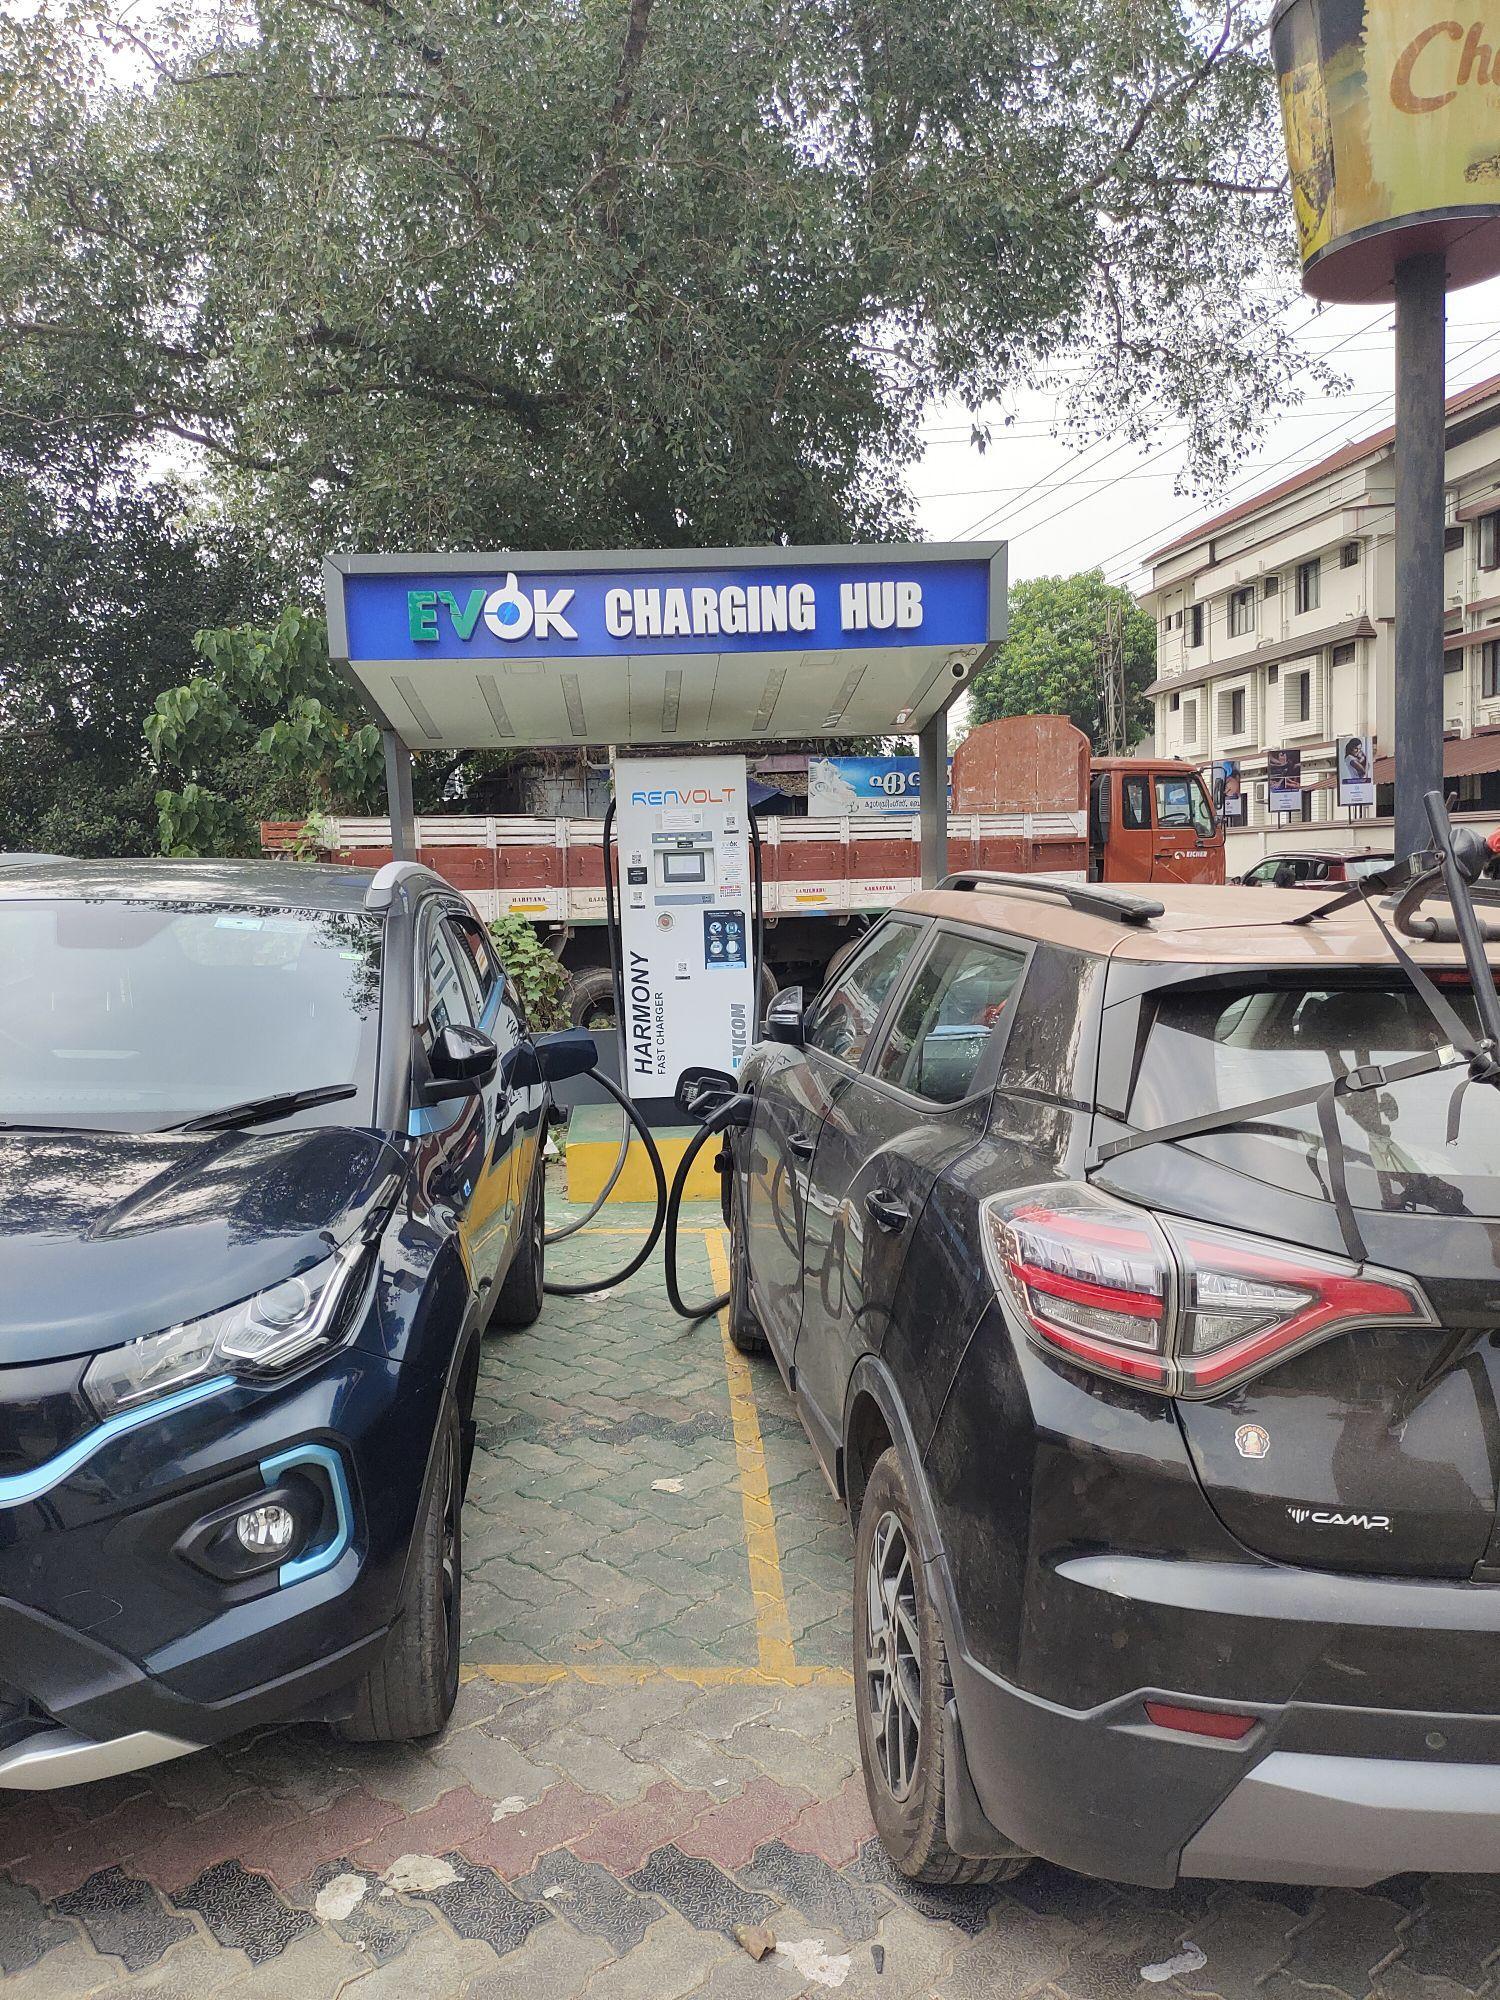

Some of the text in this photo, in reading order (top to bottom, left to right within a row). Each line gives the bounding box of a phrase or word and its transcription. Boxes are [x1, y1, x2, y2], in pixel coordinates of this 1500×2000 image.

[1390, 20, 1500, 114] Ch
[408, 572, 923, 642] EVOK CHARGING HUB
[632, 788, 736, 806] RENVOLT
[630, 950, 653, 1075] HARMONY
[655, 991, 666, 1075] FAST CHARGER
